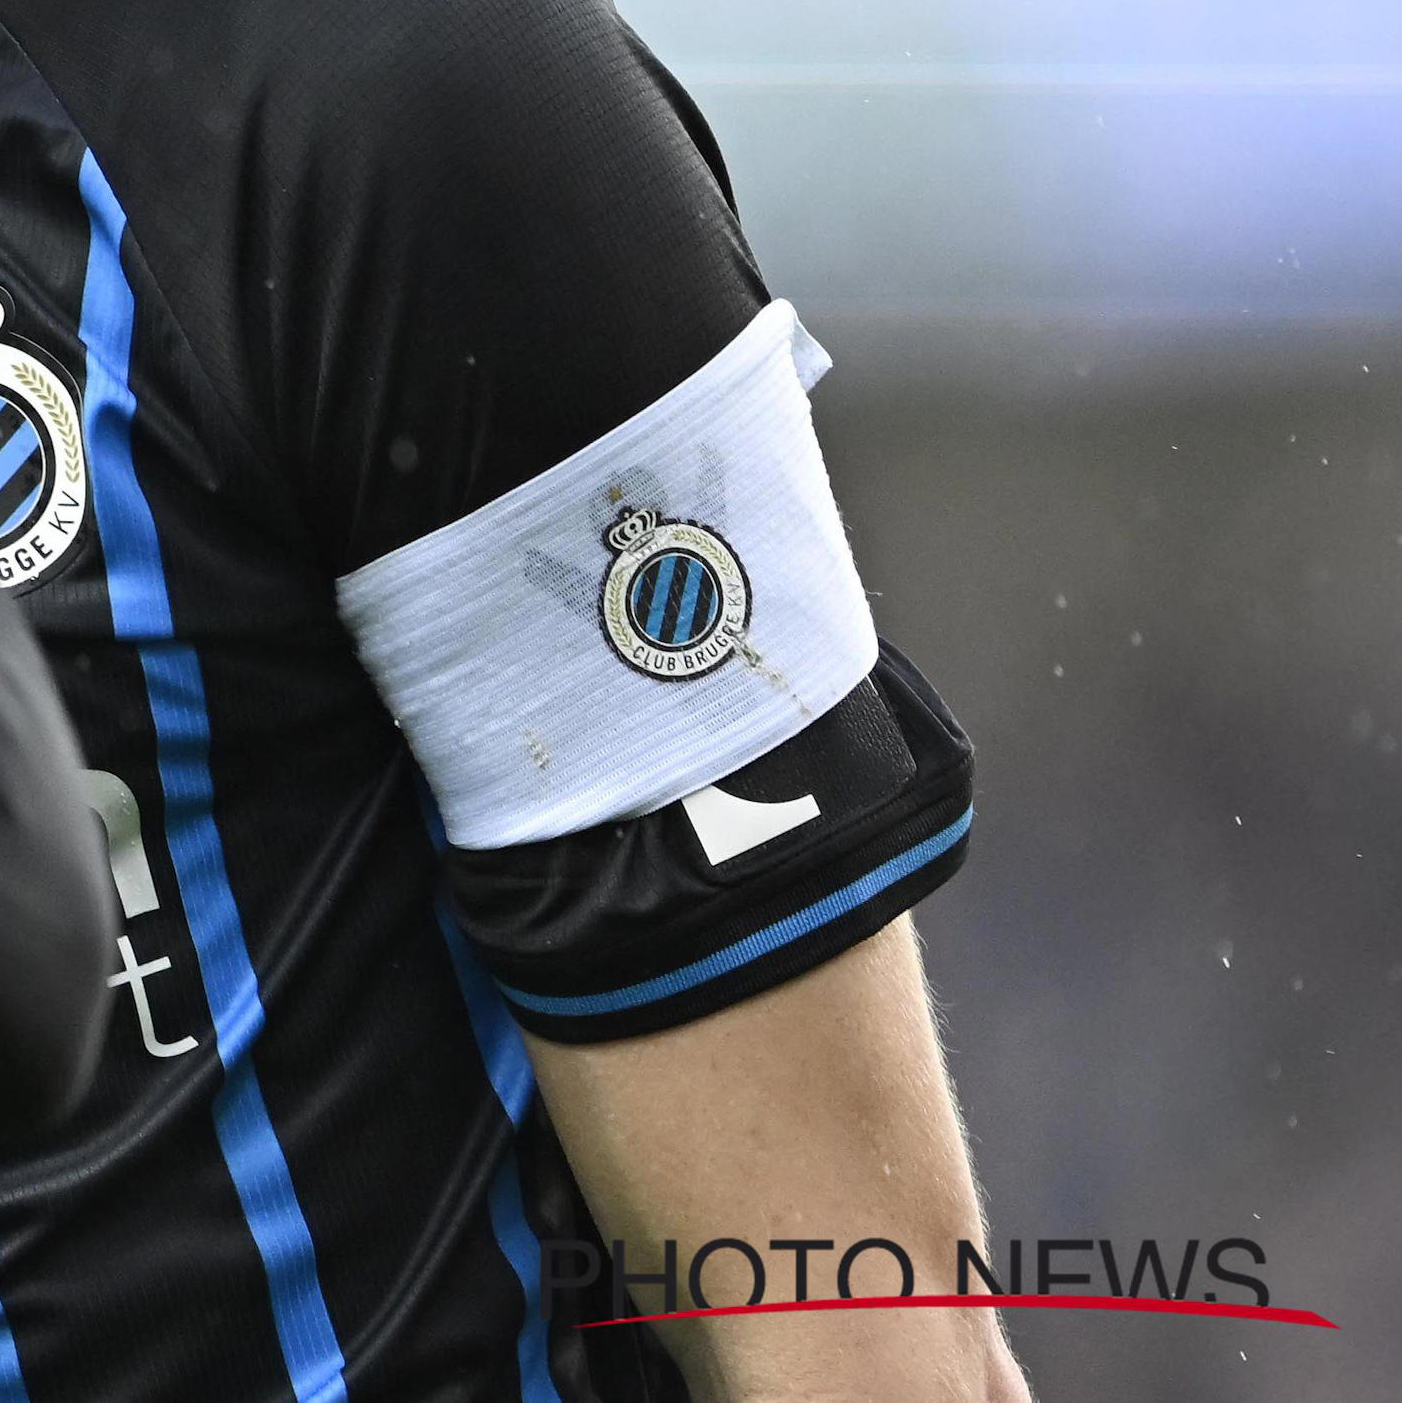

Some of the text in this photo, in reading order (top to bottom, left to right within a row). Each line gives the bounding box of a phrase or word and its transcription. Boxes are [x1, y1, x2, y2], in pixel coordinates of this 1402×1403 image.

[48, 490, 80, 534] KV
[632, 645, 676, 671] CLUB
[684, 613, 741, 669] BRUGGE
